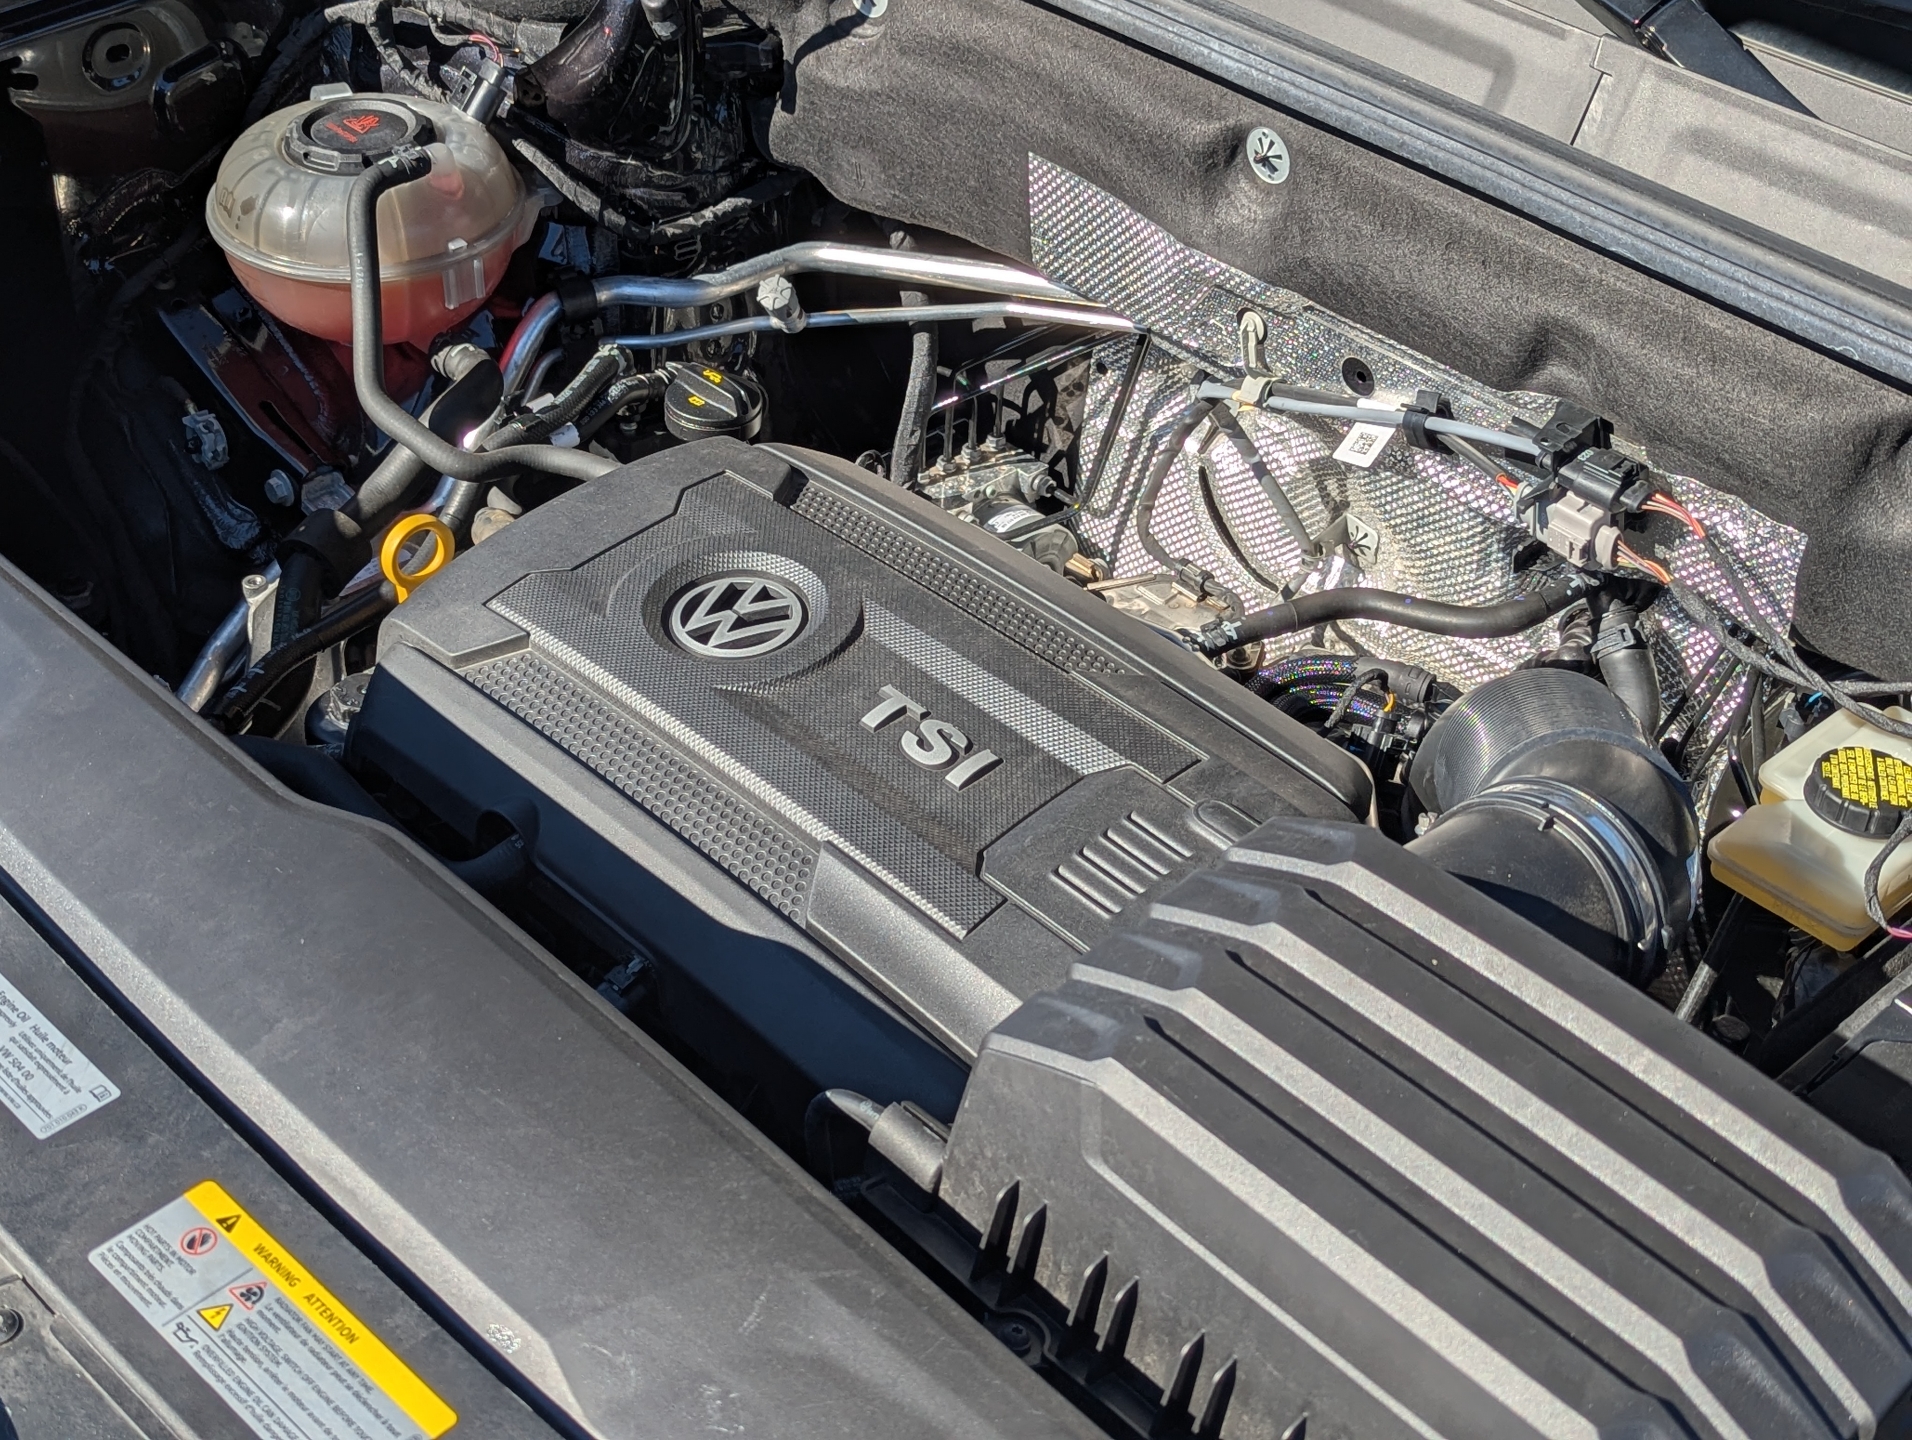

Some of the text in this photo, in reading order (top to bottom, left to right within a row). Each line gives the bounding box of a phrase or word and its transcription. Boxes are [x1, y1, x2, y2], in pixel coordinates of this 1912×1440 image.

[859, 683, 1004, 793] TSI
[16, 1011, 31, 1023] Oil
[29, 1024, 72, 1065] Huile moteur
[8, 1057, 25, 1072] 504
[21, 1070, 34, 1081] 00
[112, 1252, 149, 1289] compartiment
[127, 1234, 150, 1256] MOVING
[144, 1224, 196, 1275] HOT PARTS IN MOTOR
[115, 1241, 146, 1272] Composants
[153, 1280, 172, 1298] chauds
[170, 1297, 184, 1311] dans
[253, 1243, 359, 1344] WARNING ATTENTION
[236, 1323, 261, 1347] IGNITION
[264, 1303, 274, 1312] Le
[272, 1311, 302, 1339] ventilateur
[300, 1339, 309, 1347] de
[308, 1346, 334, 1370] radiateur
[275, 1297, 303, 1324] RADIATOR
[301, 1322, 312, 1334] FAN
[312, 1333, 325, 1344] MAY
[323, 1345, 342, 1360] START
[346, 1368, 360, 1378] ANY
[193, 1350, 226, 1385] Remplissage
[202, 1344, 235, 1377] OVERFILLED
[232, 1375, 255, 1397] ENGINE
[252, 1396, 263, 1407] OIL
[262, 1405, 275, 1418] CAN
[226, 1329, 244, 1346] Haute
[287, 1391, 310, 1412] moteur
[245, 1318, 259, 1331] HIGH
[281, 1354, 302, 1375] SWITCH
[301, 1374, 315, 1385] OFF
[312, 1384, 335, 1406] ENGINE
[332, 1405, 356, 1427] BEFORE
